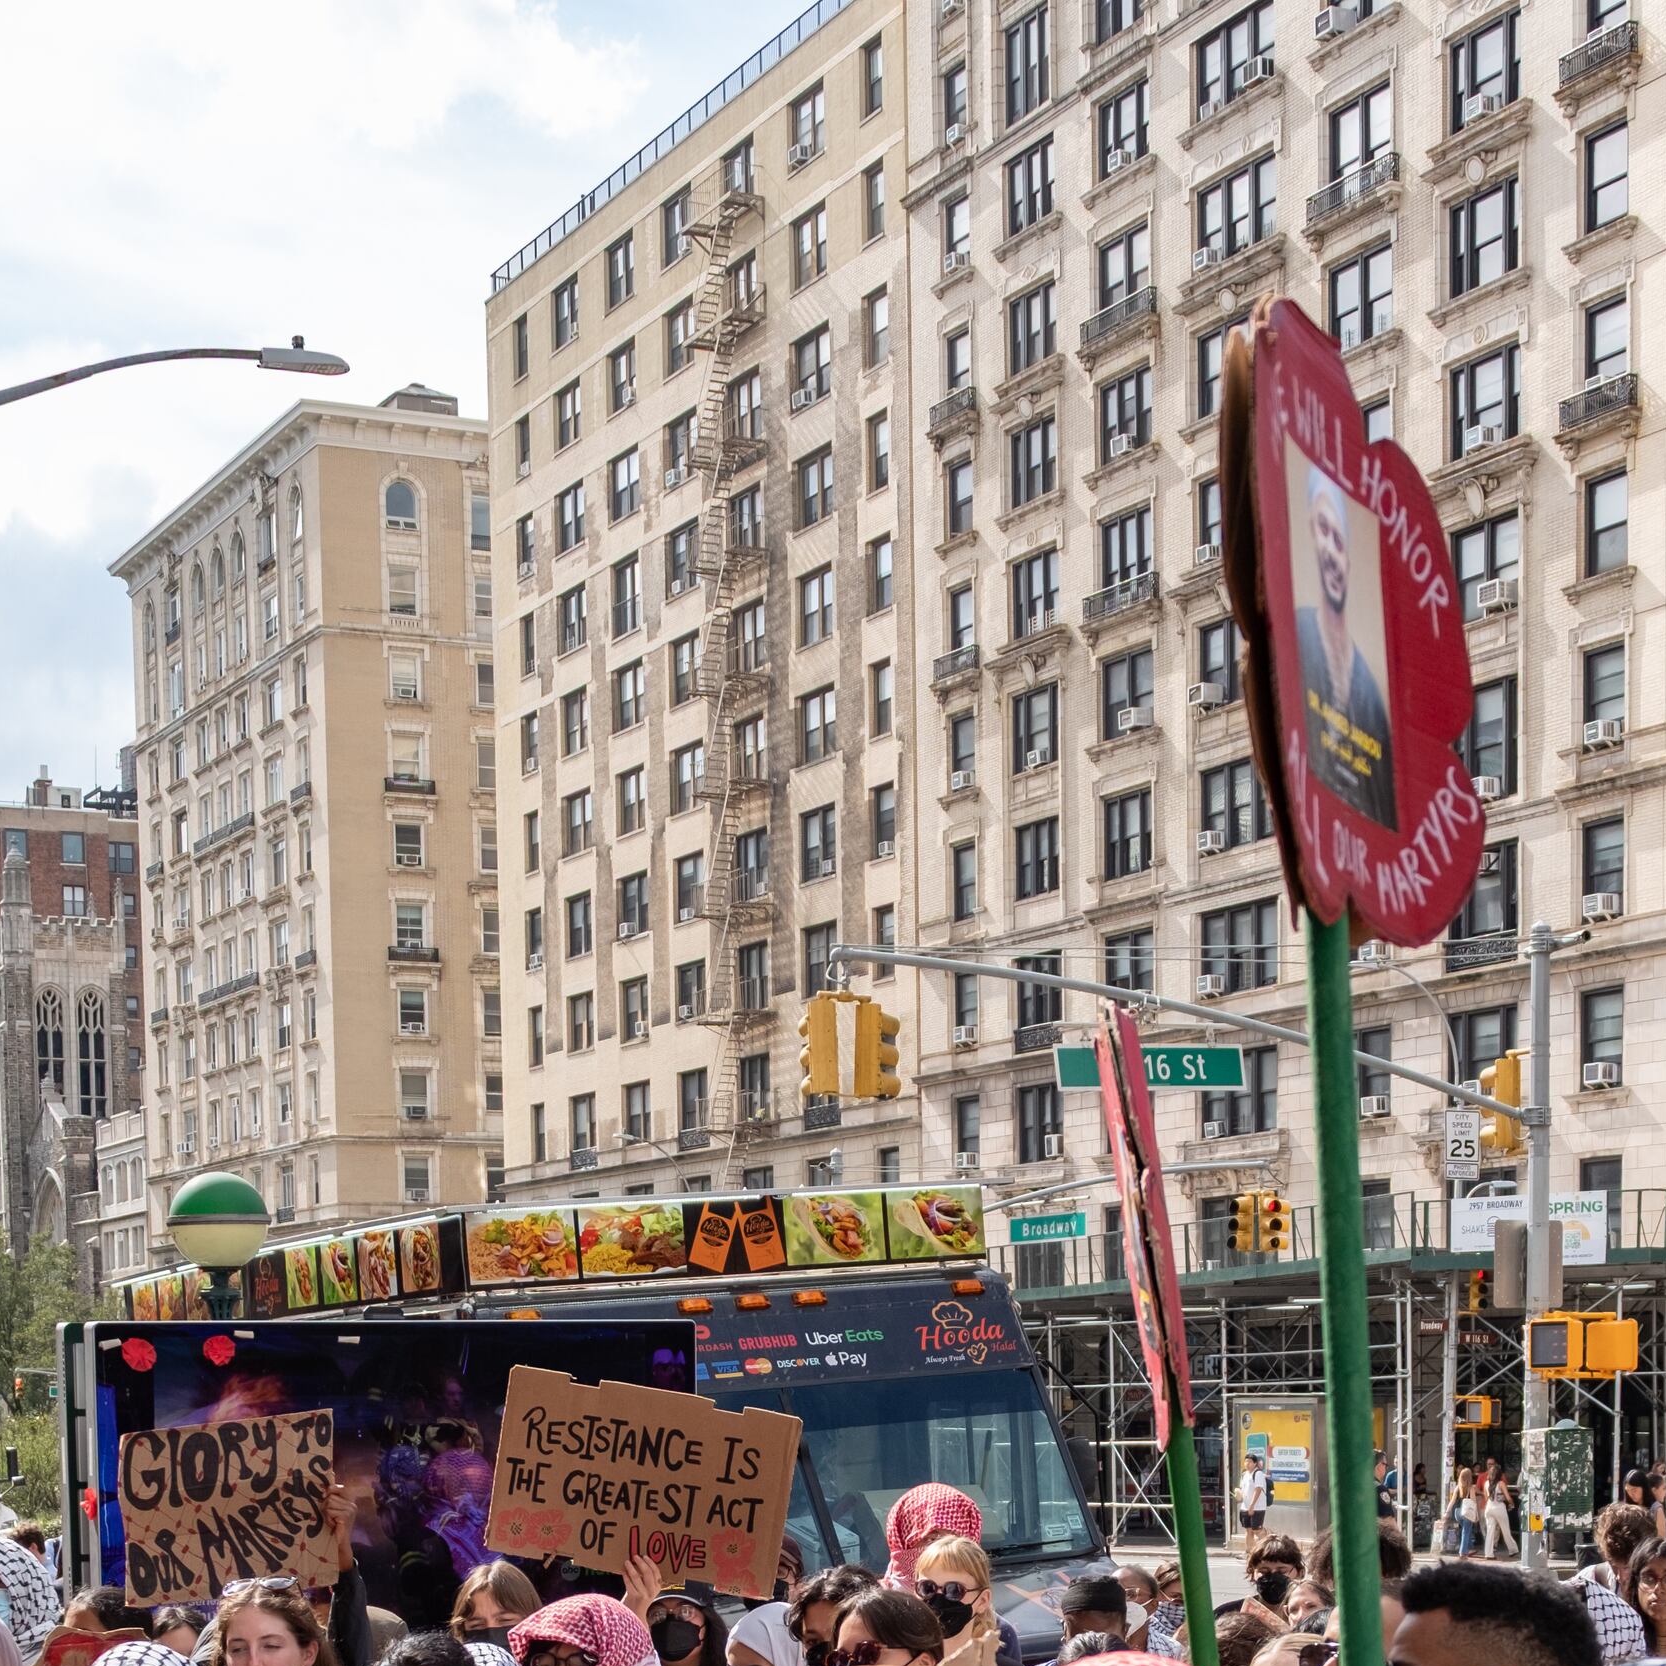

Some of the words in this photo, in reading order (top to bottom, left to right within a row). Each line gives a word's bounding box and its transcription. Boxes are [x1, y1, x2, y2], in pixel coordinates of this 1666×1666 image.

[1361, 454, 1450, 638] HONOR
[1332, 818, 1372, 885] OUR
[1376, 765, 1480, 915] MARTYRS
[1183, 1054, 1208, 1080] St
[1450, 1139, 1476, 1158] 25
[1486, 1200, 1523, 1209] BROADWAY
[1022, 1219, 1077, 1238] Broadway
[738, 1334, 798, 1351] GRUBHUB
[805, 1332, 843, 1346] Uber
[845, 1329, 885, 1343] Eats
[915, 1317, 1005, 1352] Hooda
[990, 1340, 1017, 1352] Halal
[717, 1365, 738, 1374] VISA
[839, 1351, 867, 1367] Pay
[925, 1355, 949, 1365] Always
[949, 1353, 966, 1363] Fresh
[522, 1406, 703, 1471] RESISTANCE
[717, 1437, 761, 1485] IS
[123, 1419, 278, 1512] GLORY
[291, 1413, 332, 1454] TO
[507, 1457, 552, 1503] THE
[563, 1469, 702, 1528] GREATEST
[707, 1494, 764, 1533] ACT
[580, 1519, 617, 1555] OF
[629, 1525, 707, 1574] LOVE
[128, 1528, 195, 1599] OUR
